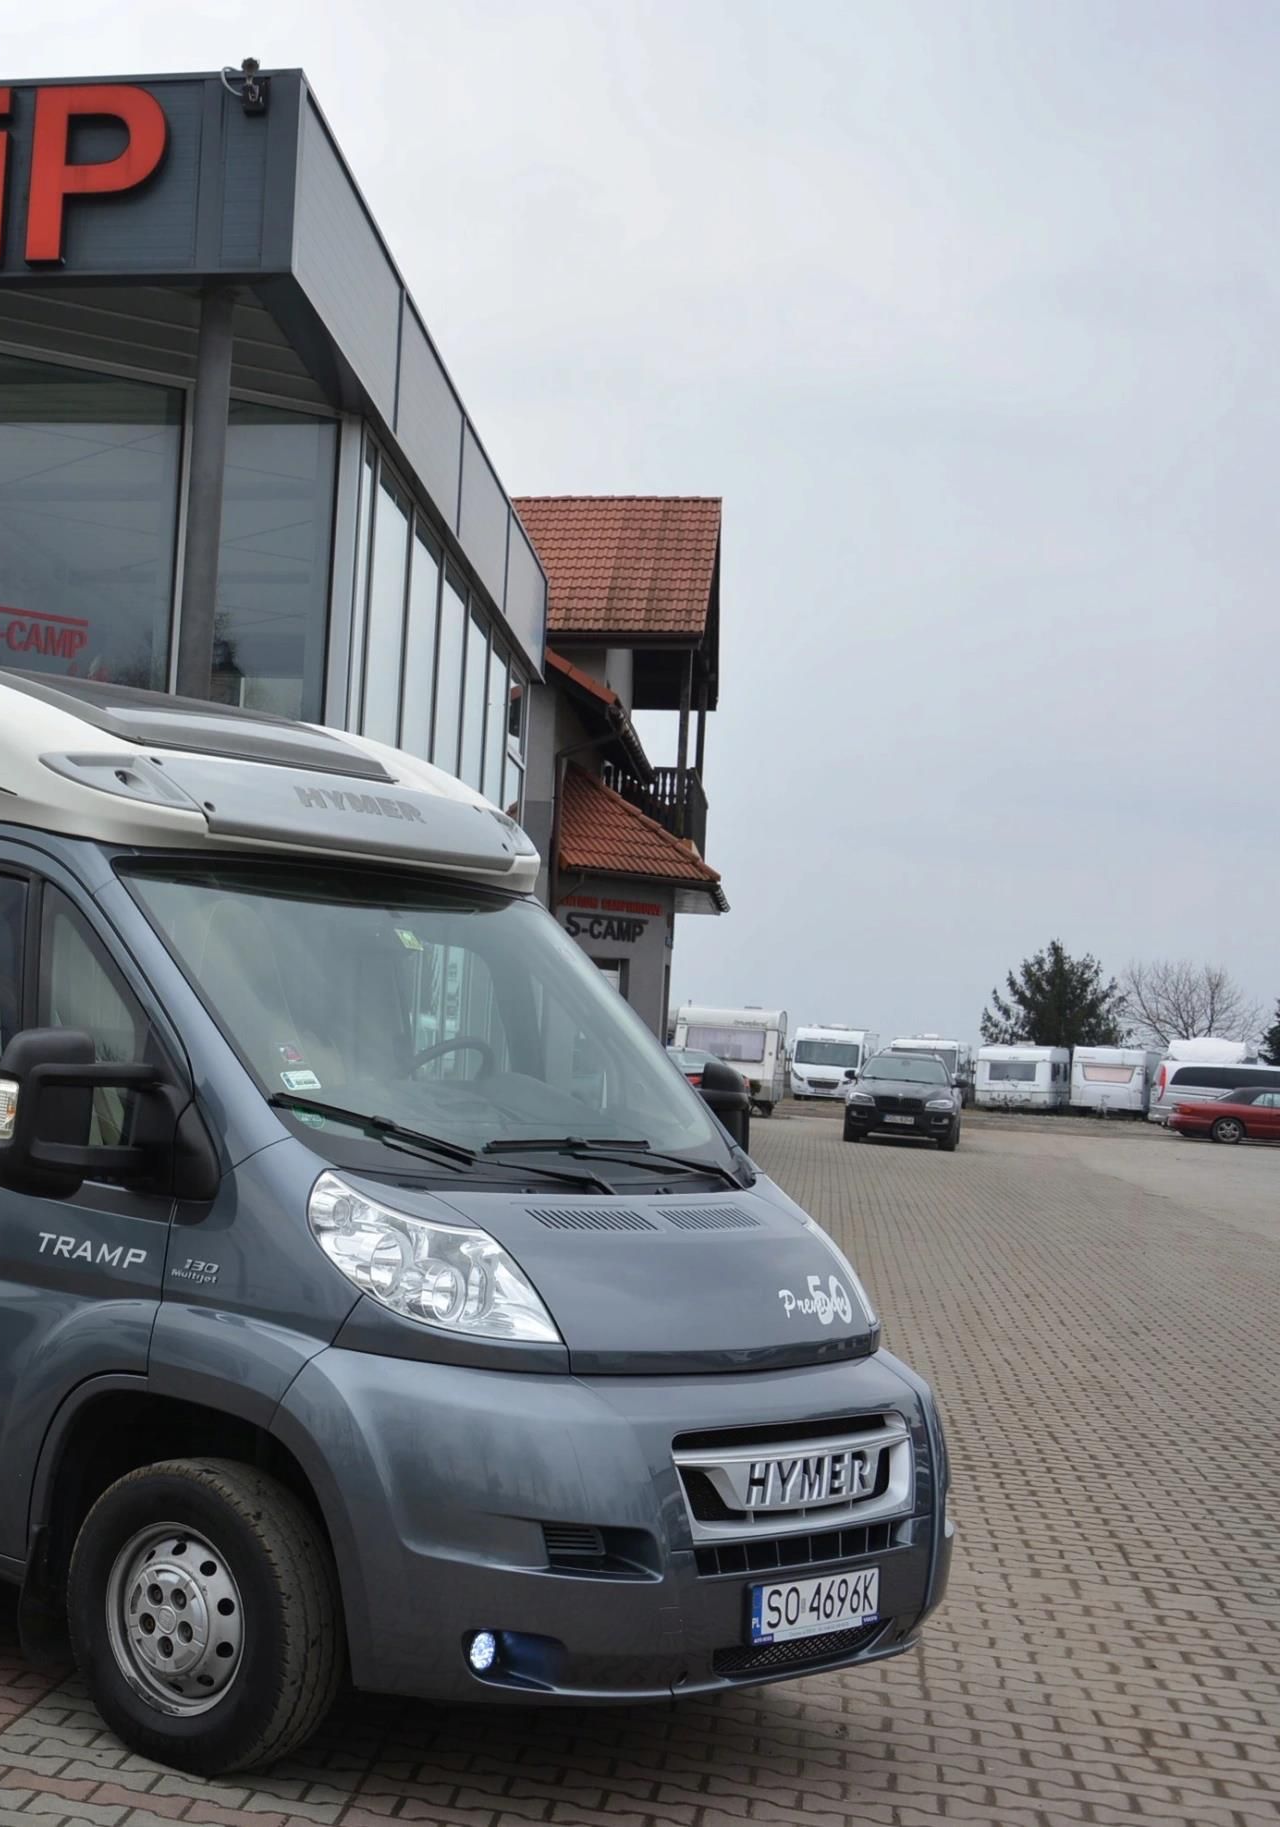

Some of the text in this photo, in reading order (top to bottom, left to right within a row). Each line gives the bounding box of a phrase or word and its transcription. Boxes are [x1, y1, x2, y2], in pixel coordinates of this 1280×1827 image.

[293, 786, 427, 824] HYMER
[565, 912, 648, 943] S-CAMP
[38, 1232, 148, 1269] TRAMP
[183, 1259, 220, 1274] 130
[807, 1275, 852, 1325] 50
[745, 1450, 872, 1506] HYMER
[767, 1573, 875, 1628] SO 4696K
